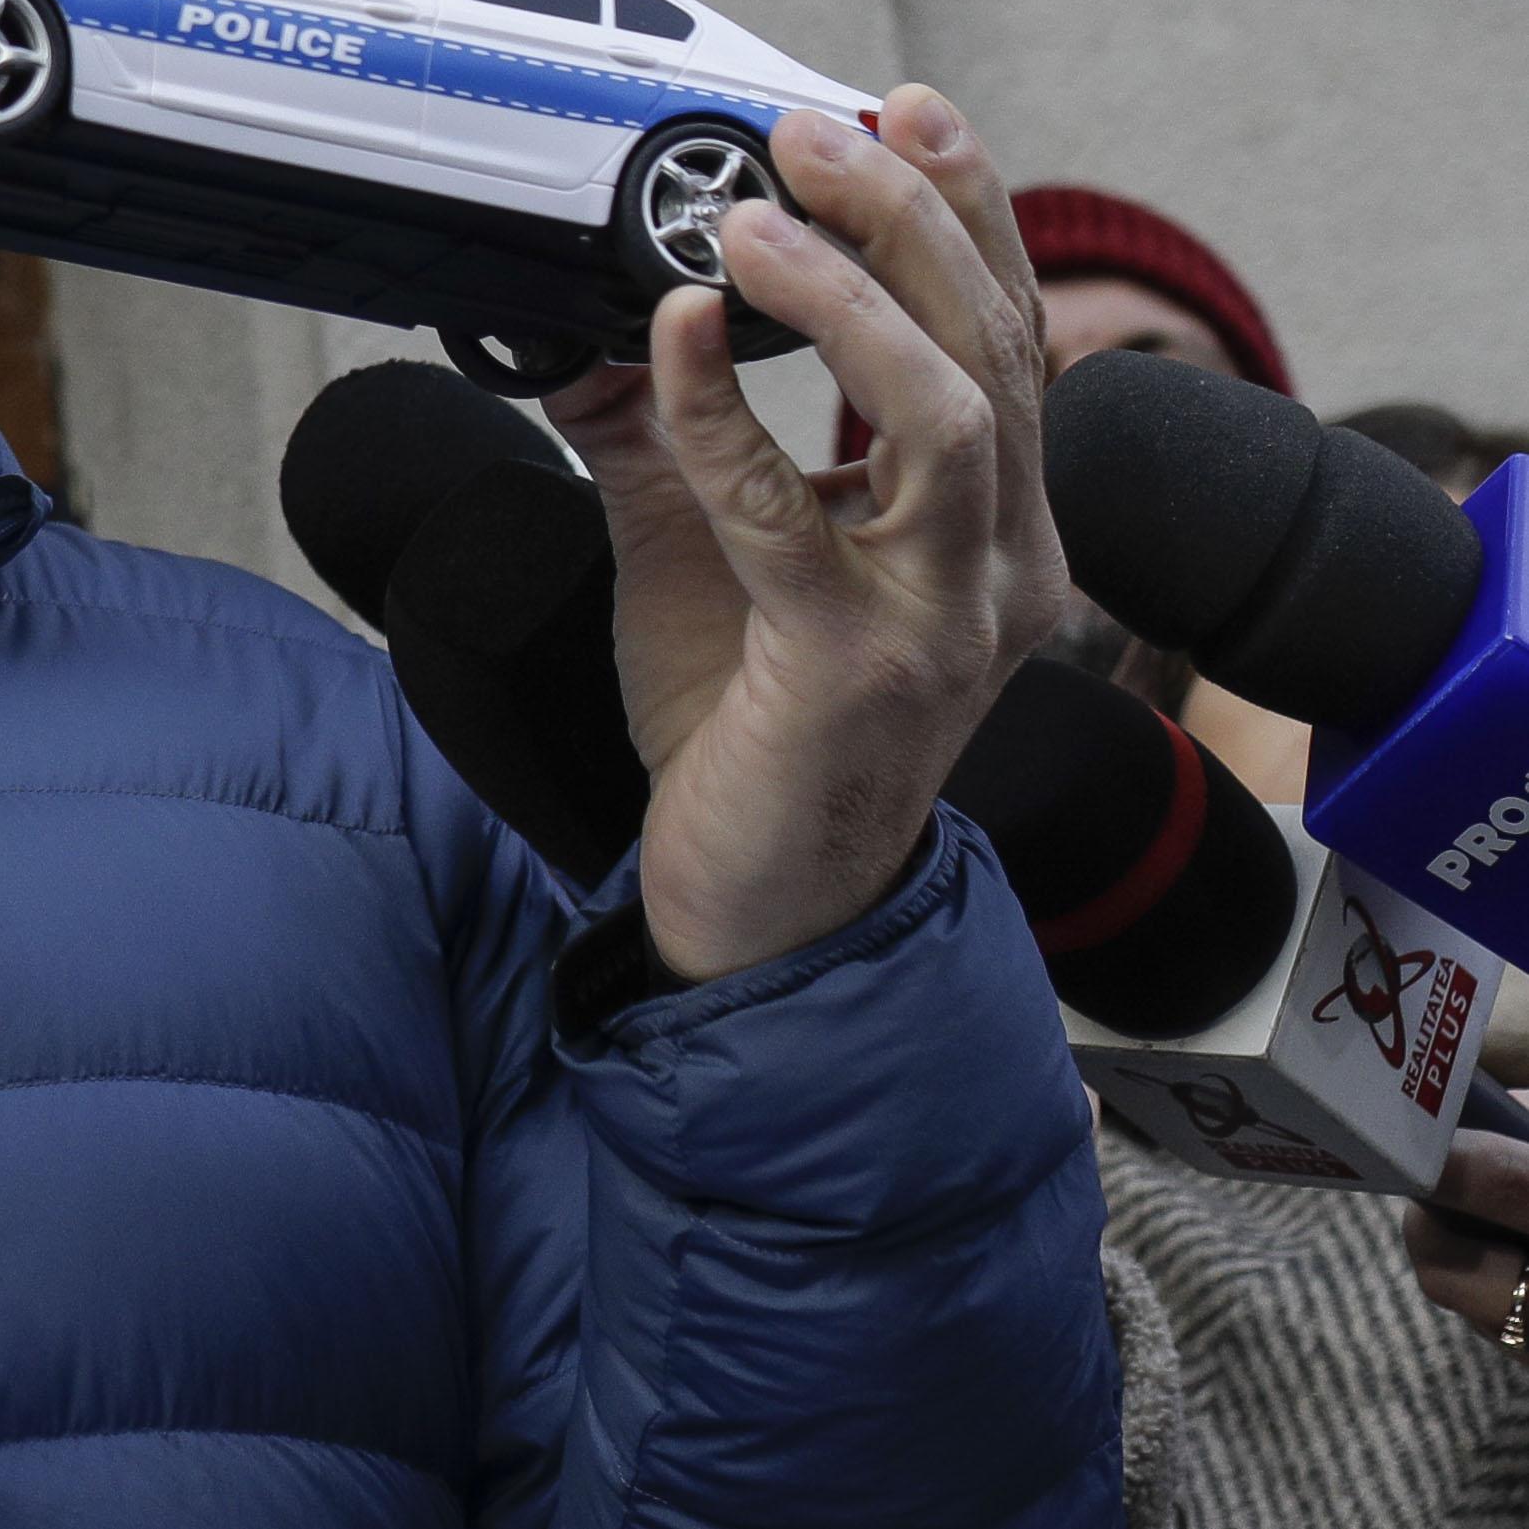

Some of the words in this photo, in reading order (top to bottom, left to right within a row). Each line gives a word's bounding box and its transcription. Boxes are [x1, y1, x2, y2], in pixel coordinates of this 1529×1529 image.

[177, 3, 367, 65] POLICE
[1401, 956, 1455, 1099] REALITATEA
[1427, 989, 1467, 1089] PLUS
